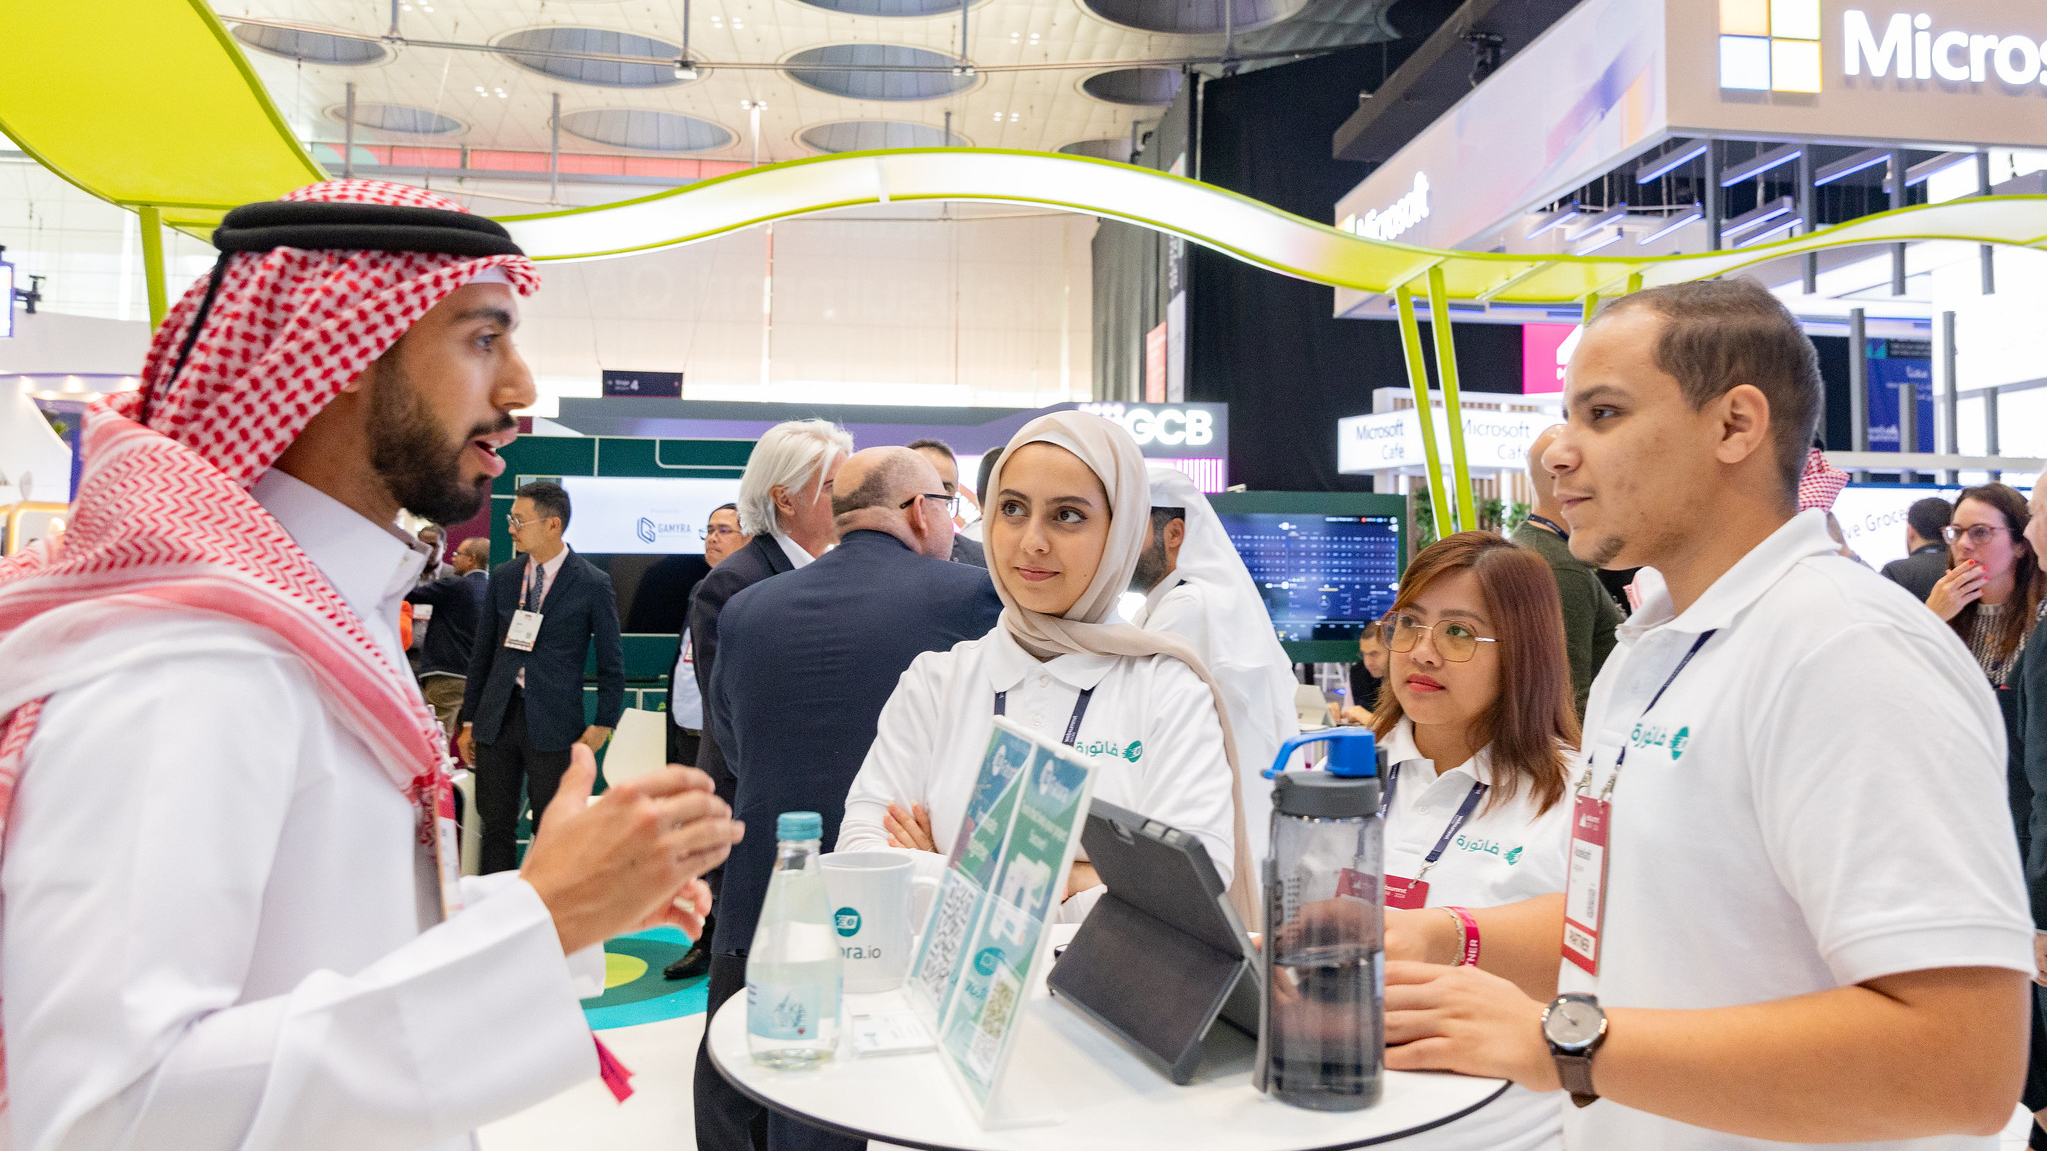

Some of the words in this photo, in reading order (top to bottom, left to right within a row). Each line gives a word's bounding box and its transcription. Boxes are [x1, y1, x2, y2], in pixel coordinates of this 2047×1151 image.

[1843, 9, 2047, 86] Micro
[1125, 408, 1213, 446] GCB
[1356, 419, 1404, 441] Microsoft
[658, 523, 692, 533] GAMYRA
[1631, 723, 1667, 749] فاتورة
[1076, 740, 1118, 757] فاتورة
[1456, 835, 1500, 856] فاتورة
